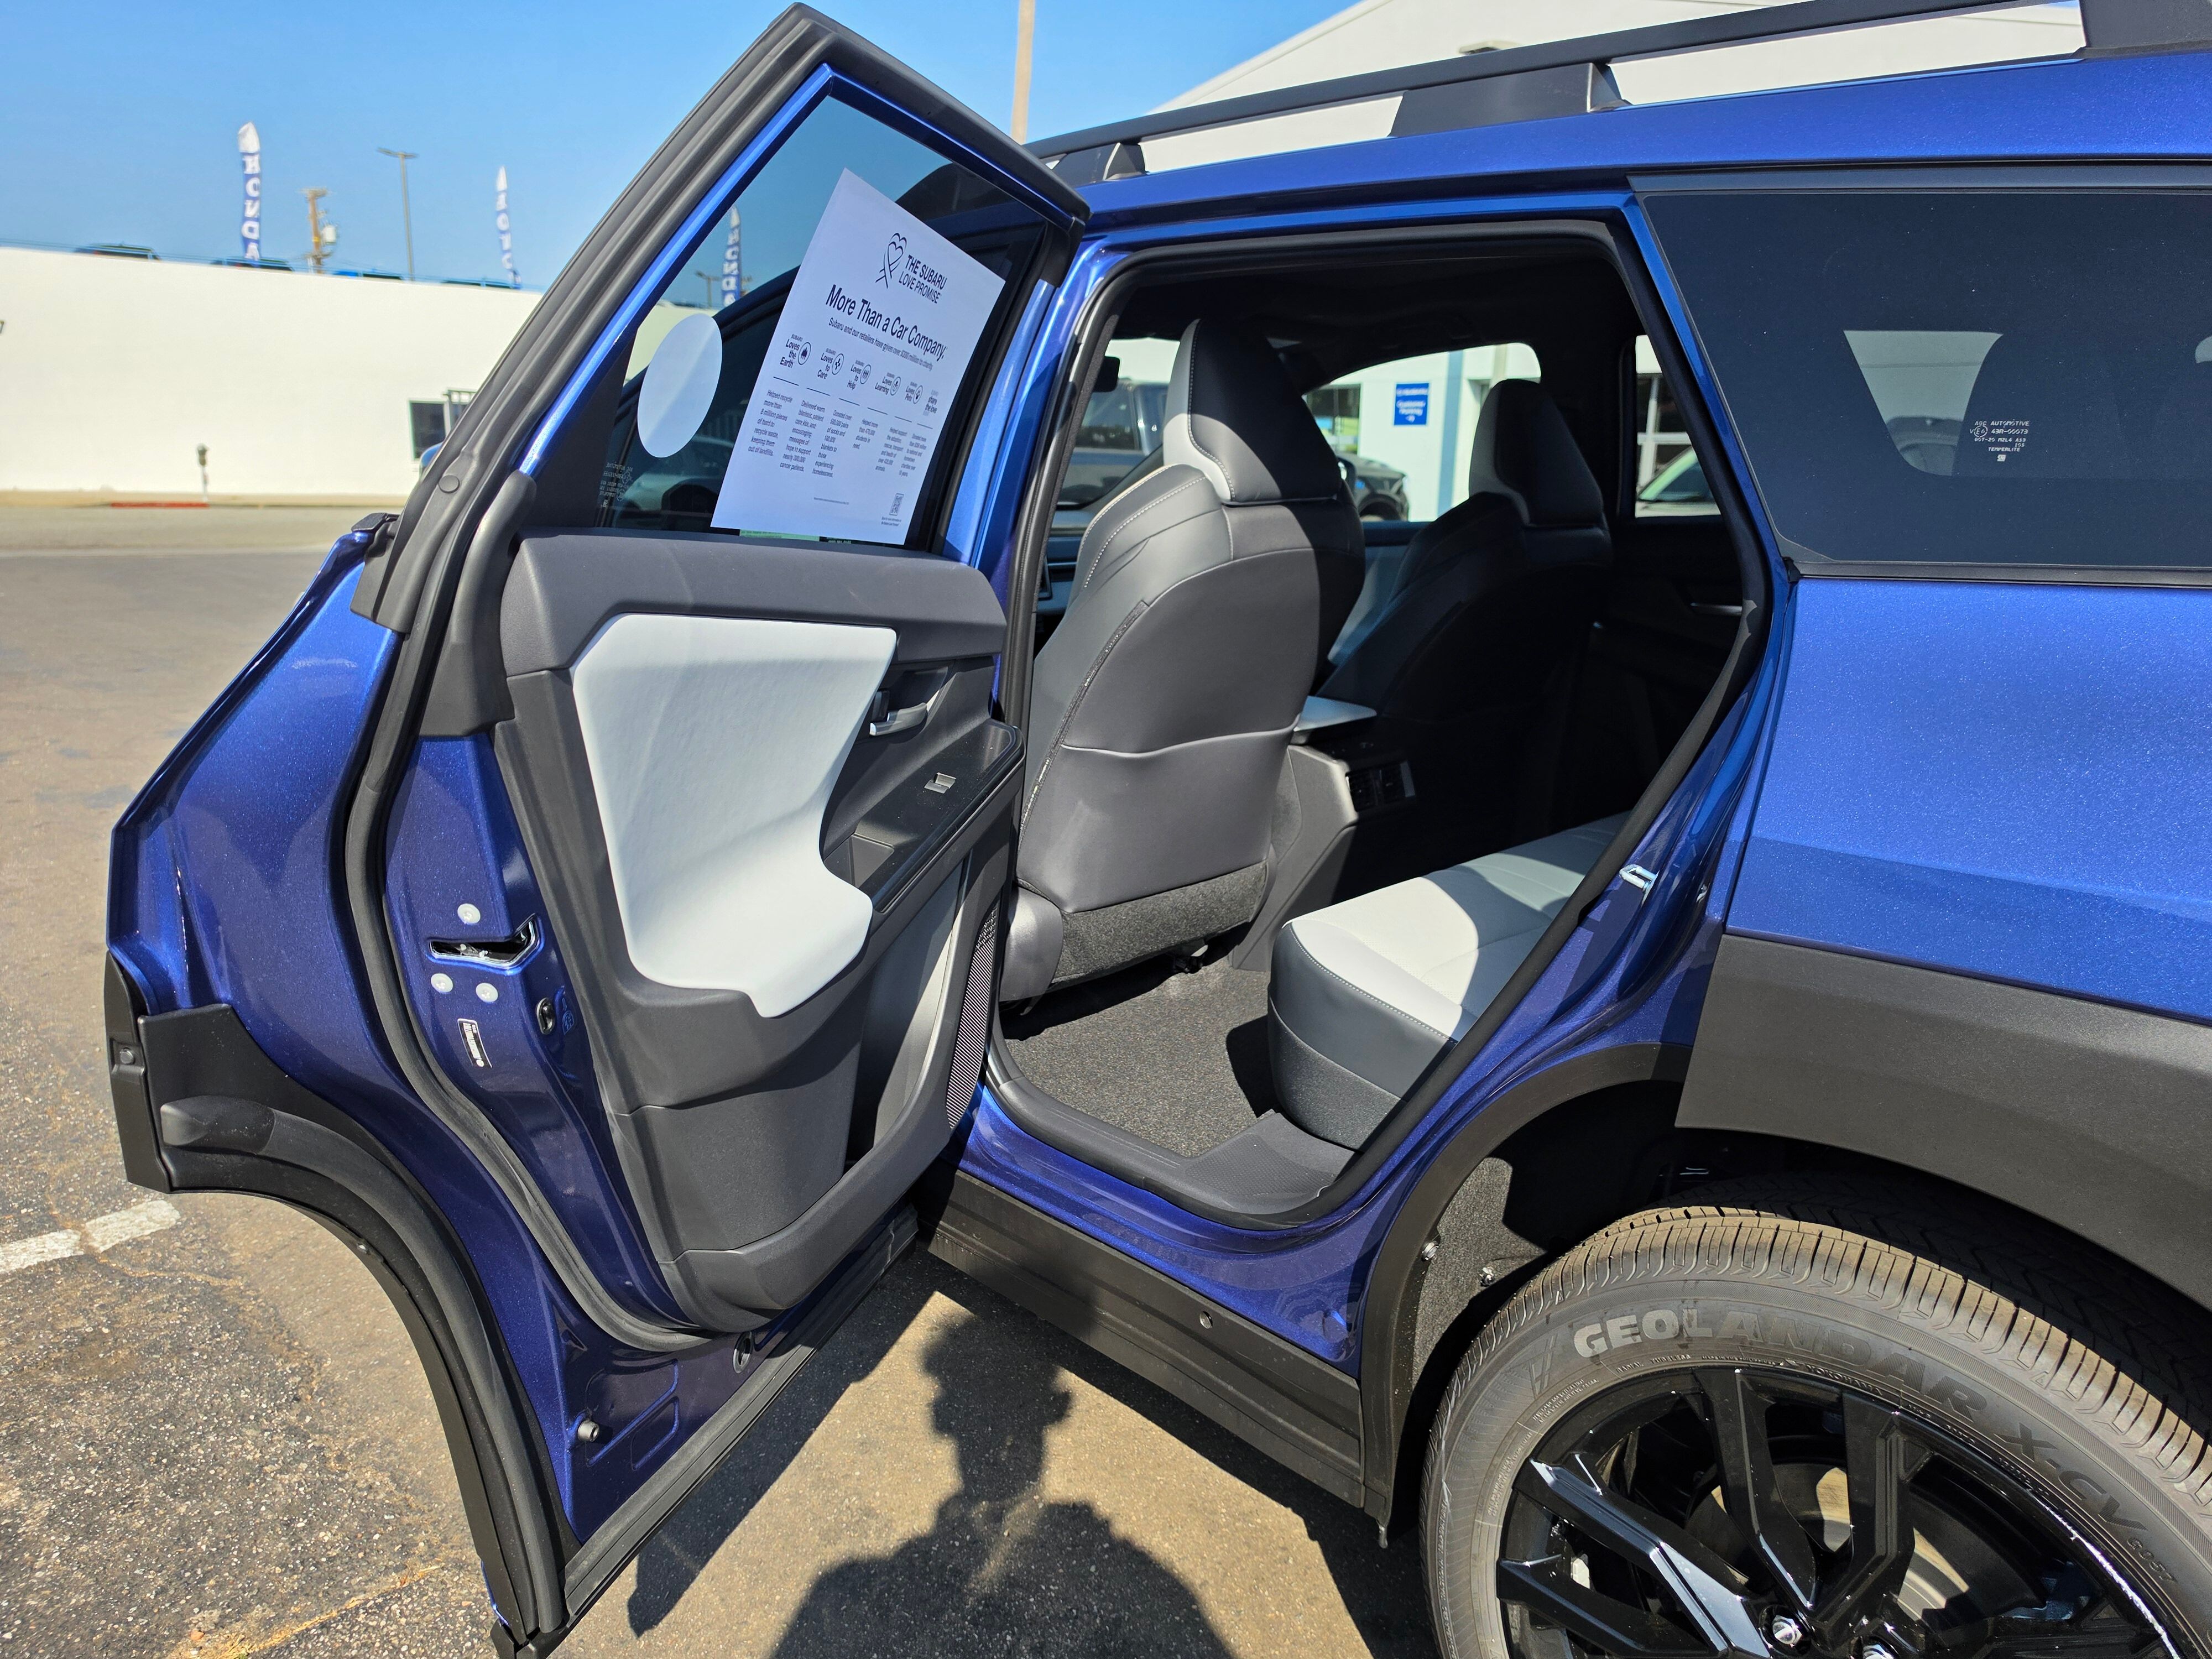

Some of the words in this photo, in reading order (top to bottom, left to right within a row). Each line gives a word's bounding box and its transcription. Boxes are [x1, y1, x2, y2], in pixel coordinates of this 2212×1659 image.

[905, 254, 921, 275] THE
[919, 264, 947, 290] SUBARU
[899, 271, 916, 290] LOVE
[914, 280, 941, 304] PROMISE
[826, 284, 856, 316] More
[857, 299, 883, 328] Than
[882, 317, 890, 332] a
[891, 316, 909, 340] Car
[828, 317, 844, 331] Subaru
[843, 326, 853, 334] and
[859, 332, 875, 344] retailers
[874, 338, 884, 348] have
[882, 343, 894, 352] given
[893, 348, 901, 356] over
[785, 338, 800, 351] Loves
[780, 357, 794, 368] Earth
[821, 353, 833, 364] Loves
[817, 369, 828, 379] Care
[851, 364, 862, 374] Loves
[847, 380, 856, 390] Help
[882, 377, 893, 386] Loves
[766, 389, 781, 399] Helped
[875, 382, 889, 395] Learning
[905, 385, 915, 395] Loves
[801, 400, 818, 411] Delivered
[927, 396, 937, 405] share
[821, 443, 835, 452] blankets
[780, 462, 792, 471] cancer
[1573, 1309, 1988, 1422] GEOLANDAR
[1805, 1363, 1883, 1396] YOKOHAMA
